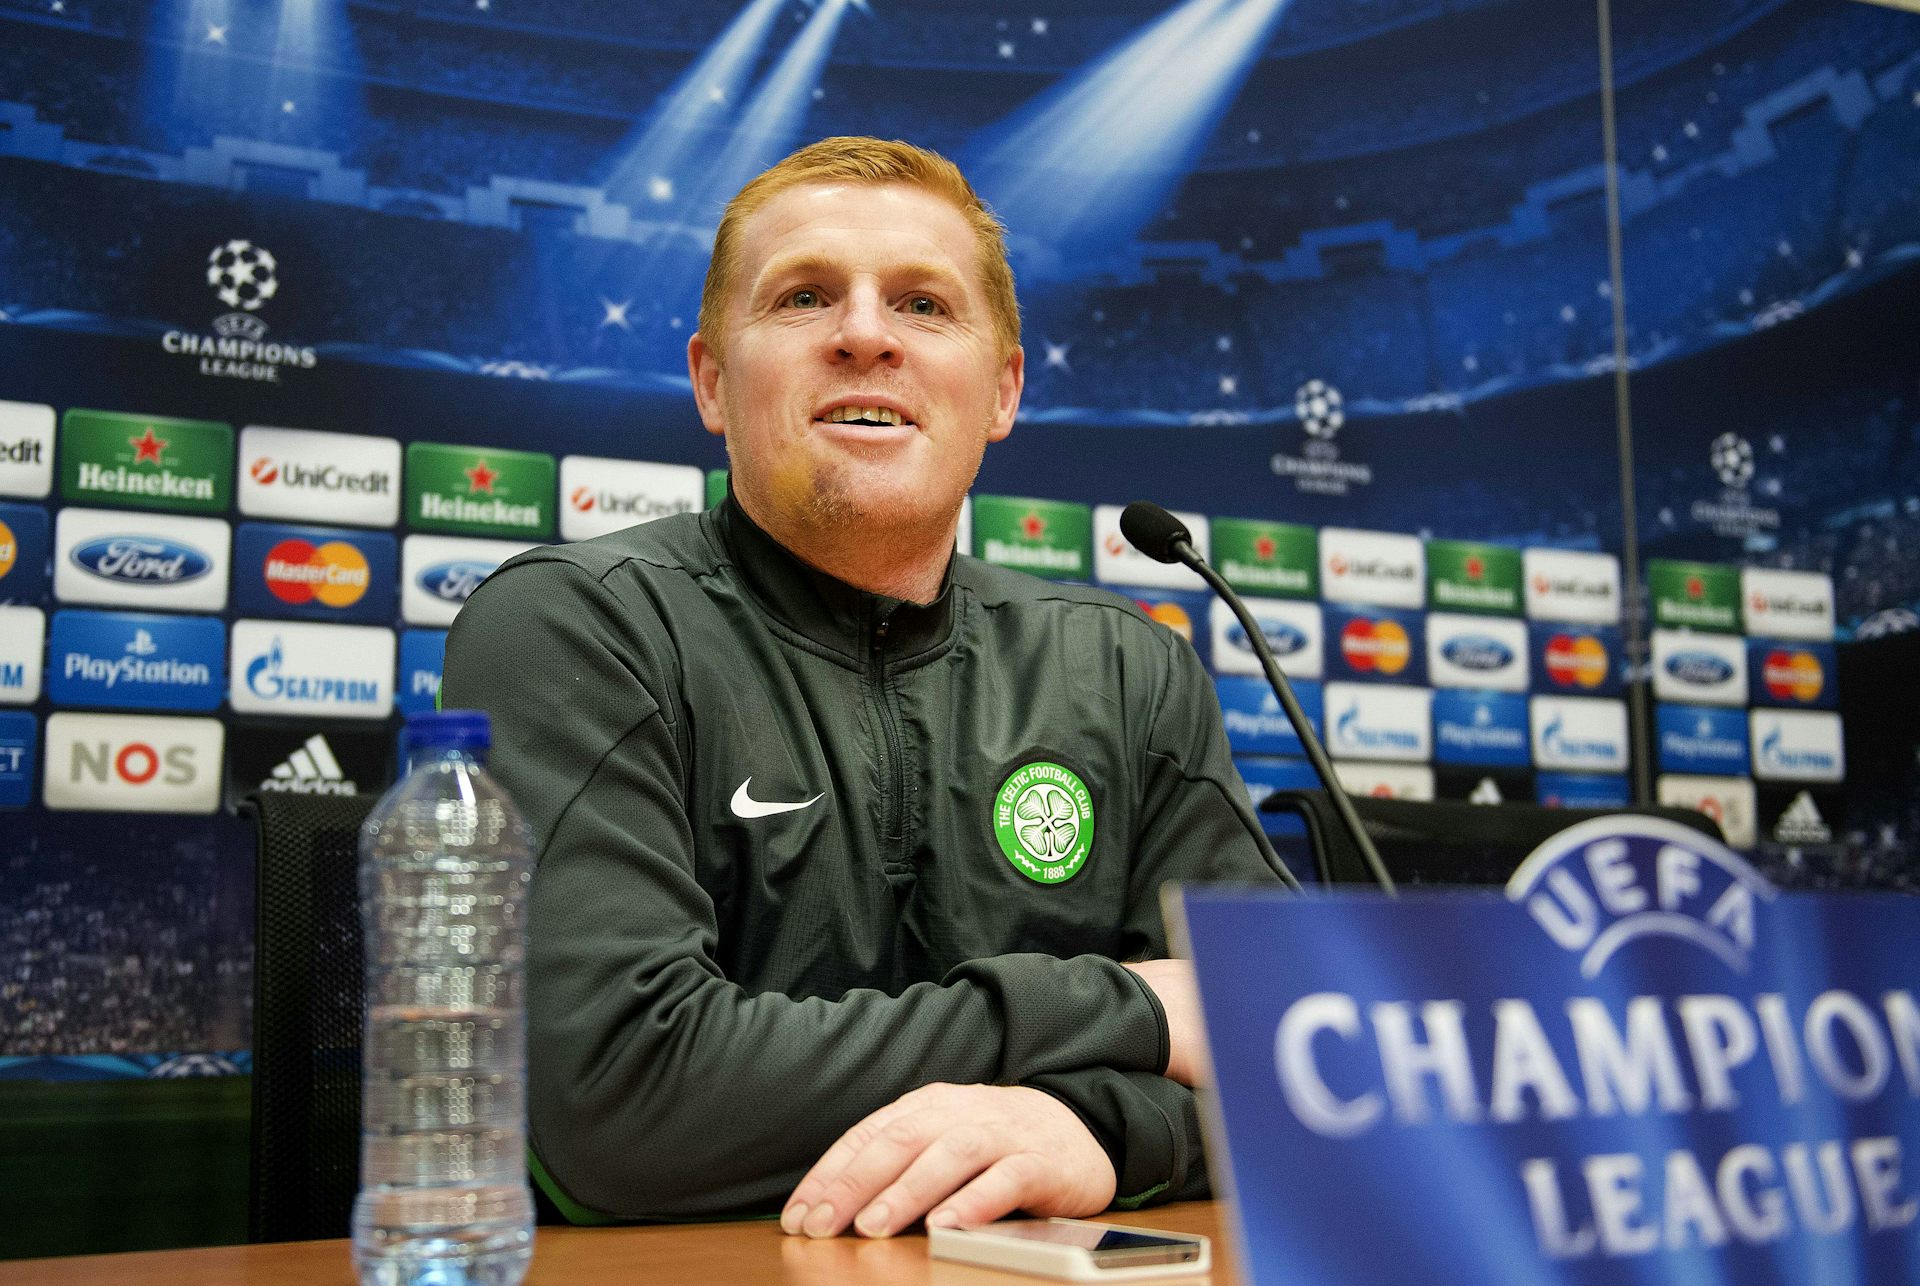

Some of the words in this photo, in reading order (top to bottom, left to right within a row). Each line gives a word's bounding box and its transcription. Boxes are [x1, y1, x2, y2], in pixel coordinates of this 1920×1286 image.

[162, 329, 317, 369] CHAMPIONS
[201, 358, 279, 383] LEAGUE
[78, 462, 214, 501] Heineken
[283, 465, 389, 495] UniCredit
[421, 491, 541, 527] Heineken
[98, 538, 185, 581] Ford
[265, 559, 369, 586] MasterCard
[65, 652, 209, 688] PlayStation
[285, 675, 379, 704] GAZPROM
[70, 740, 198, 787] NOS
[1028, 766, 1077, 793] FOOTBALL
[1002, 770, 1030, 804] CELTIC
[999, 804, 1011, 828] THE
[1074, 789, 1091, 820] CLUB
[1043, 866, 1066, 880] 1888
[1527, 836, 1757, 953] UEFA
[1523, 1137, 1919, 1258] LEAGUE
